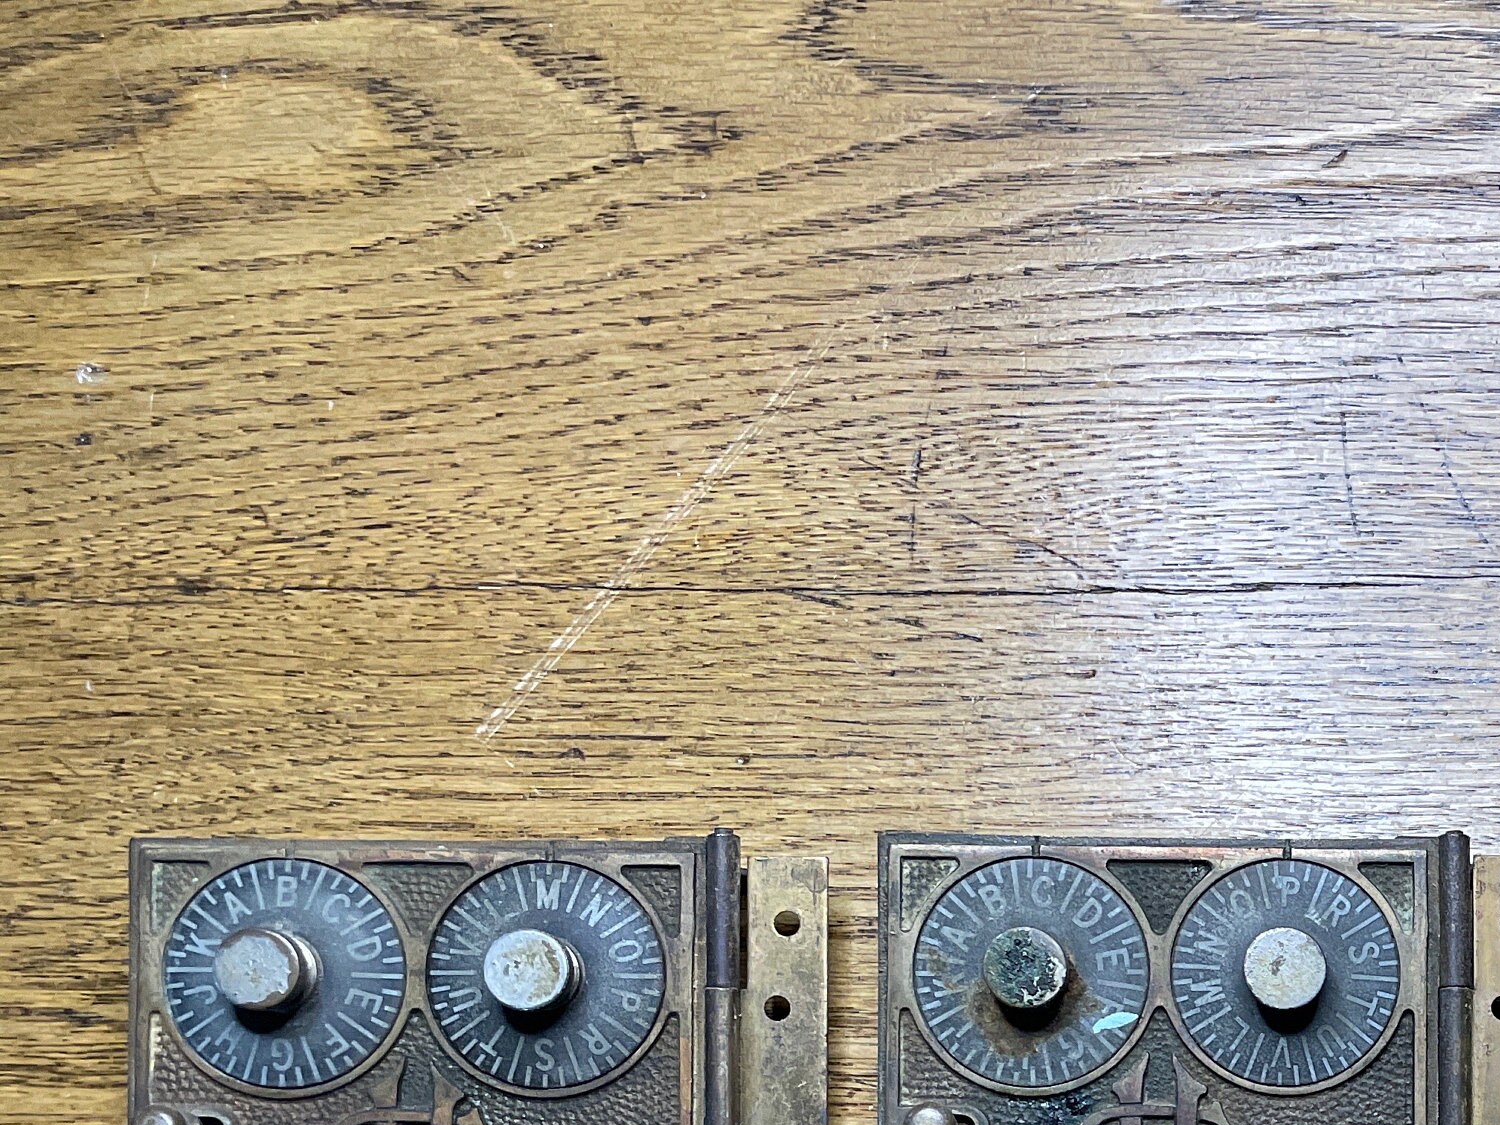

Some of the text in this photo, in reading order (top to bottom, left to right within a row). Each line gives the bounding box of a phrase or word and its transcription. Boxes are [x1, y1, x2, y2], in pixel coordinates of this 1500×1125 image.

[276, 876, 298, 907] B
[536, 879, 561, 910] M
[1277, 876, 1301, 908] P
[224, 892, 252, 924] A
[322, 893, 350, 923] C
[579, 893, 613, 928] N
[939, 924, 977, 953] A
[978, 884, 1006, 919] B
[1031, 875, 1056, 908] C
[1071, 900, 1103, 929] D
[1095, 948, 1130, 971] E
[1322, 894, 1351, 928] R
[184, 931, 223, 957] K
[346, 935, 382, 962] D
[608, 939, 644, 963] O
[1193, 930, 1230, 958] N
[1348, 941, 1380, 965] S
[183, 985, 218, 1005] J
[344, 988, 384, 1015] E
[448, 986, 483, 1013] U
[611, 988, 641, 1012] P
[1190, 978, 1227, 1008] M
[1347, 994, 1379, 1017] T
[324, 1023, 350, 1058] F
[478, 1024, 506, 1057] T
[578, 1022, 613, 1056] R
[1229, 1016, 1250, 1051] L
[1317, 1024, 1348, 1058] U
[271, 1038, 294, 1072] G
[534, 1038, 555, 1072] S
[1270, 1037, 1291, 1069] V
